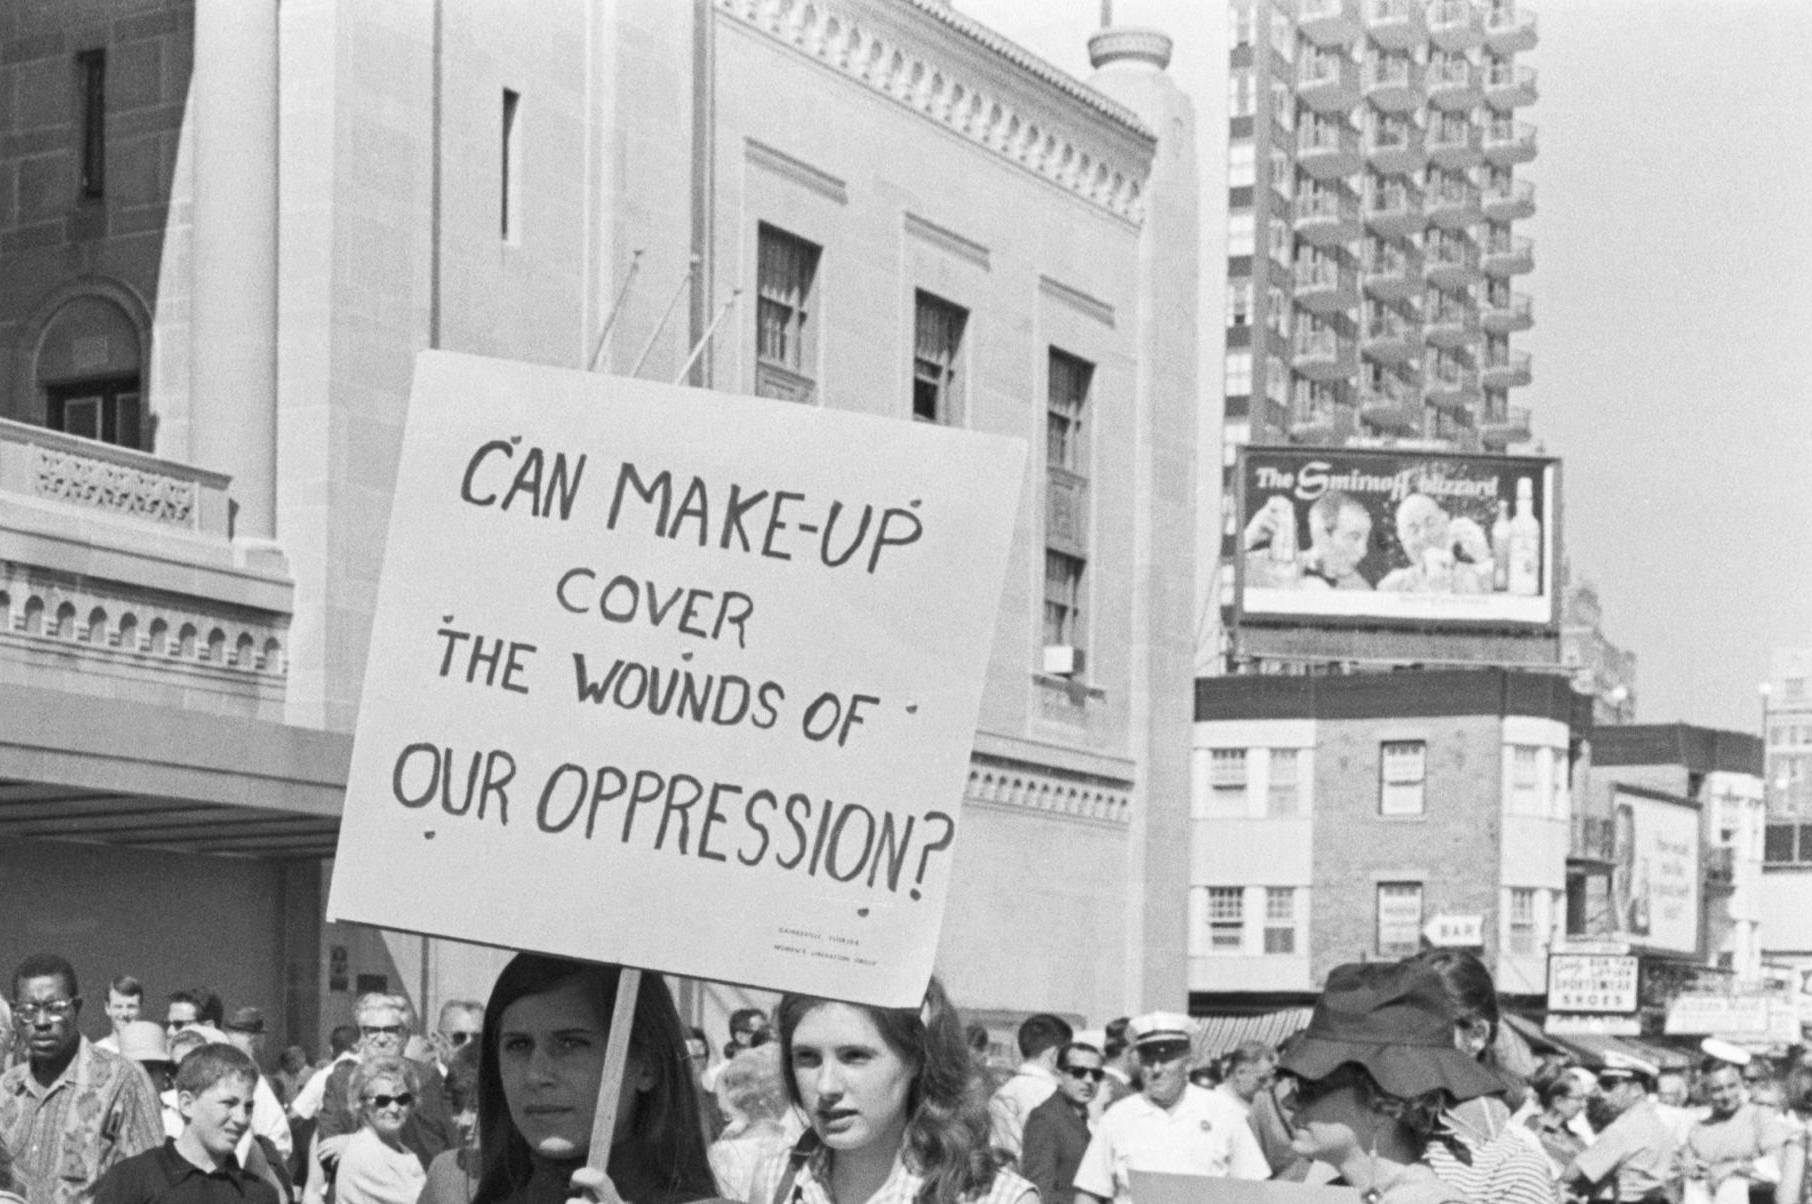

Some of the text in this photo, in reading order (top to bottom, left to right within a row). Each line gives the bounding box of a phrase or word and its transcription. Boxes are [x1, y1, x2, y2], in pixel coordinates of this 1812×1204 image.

[460, 440, 924, 574] CAN MAKE-UP
[1255, 466, 1294, 489] The
[1294, 461, 1412, 501] Smirnoff
[557, 567, 754, 648] COVER
[437, 628, 881, 747] THE WOUNDS OF
[392, 742, 955, 902] OUR OPPRESSION?
[829, 935, 860, 946] FLORIDA
[1440, 924, 1474, 938] BAR
